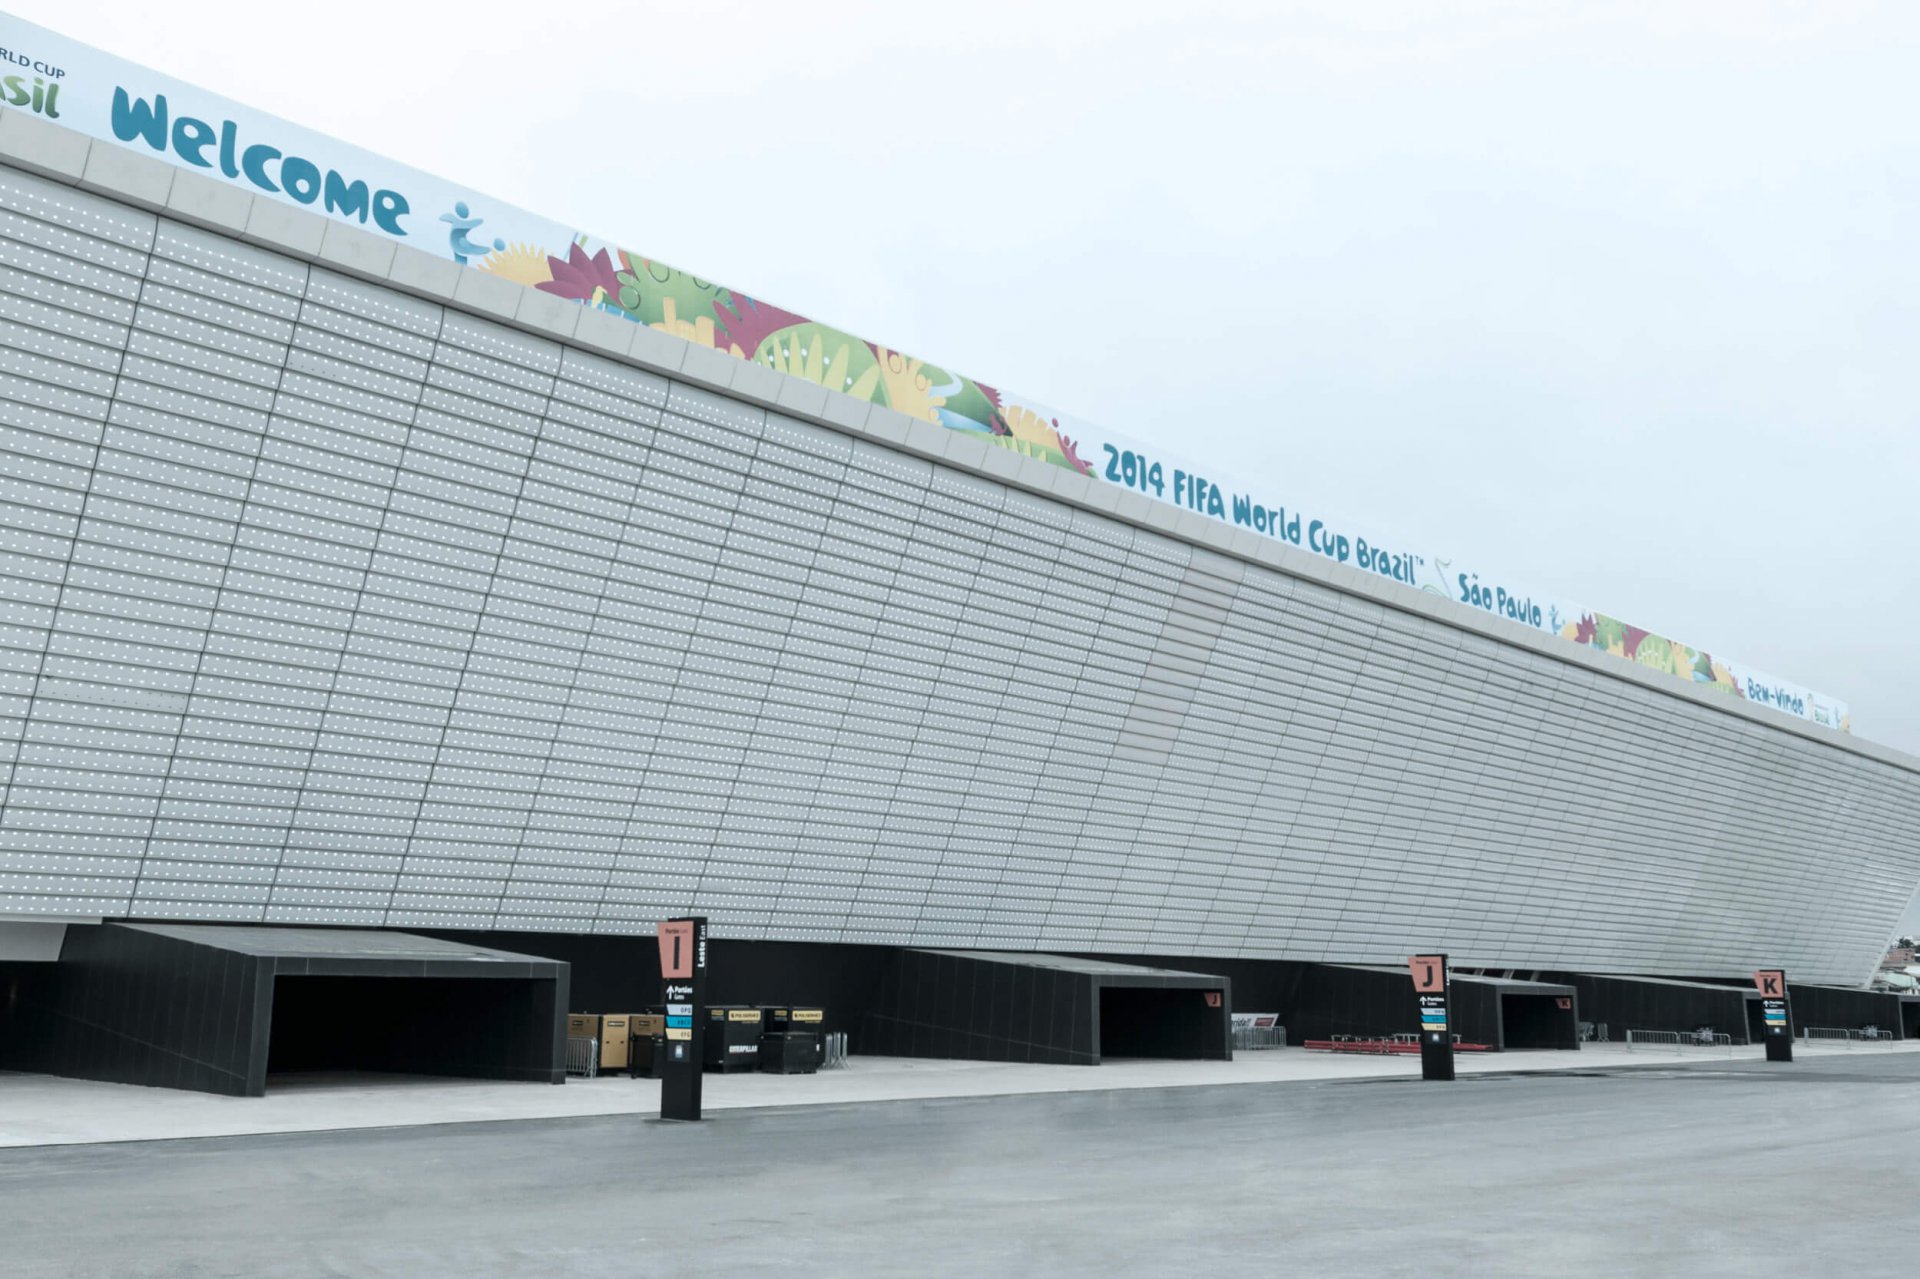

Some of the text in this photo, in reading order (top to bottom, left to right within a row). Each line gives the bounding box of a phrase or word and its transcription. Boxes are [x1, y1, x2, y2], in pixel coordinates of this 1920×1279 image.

[34, 61, 65, 79] CUP
[0, 75, 60, 118] sil
[111, 86, 410, 236] Welcome
[1103, 443, 1165, 497] 2014
[1173, 469, 1225, 520] FIFA
[1232, 494, 1301, 546] World
[1308, 519, 1350, 563] Cup
[1458, 573, 1542, 628] São Paulo
[1422, 965, 1433, 987] J
[1763, 978, 1778, 994] K
